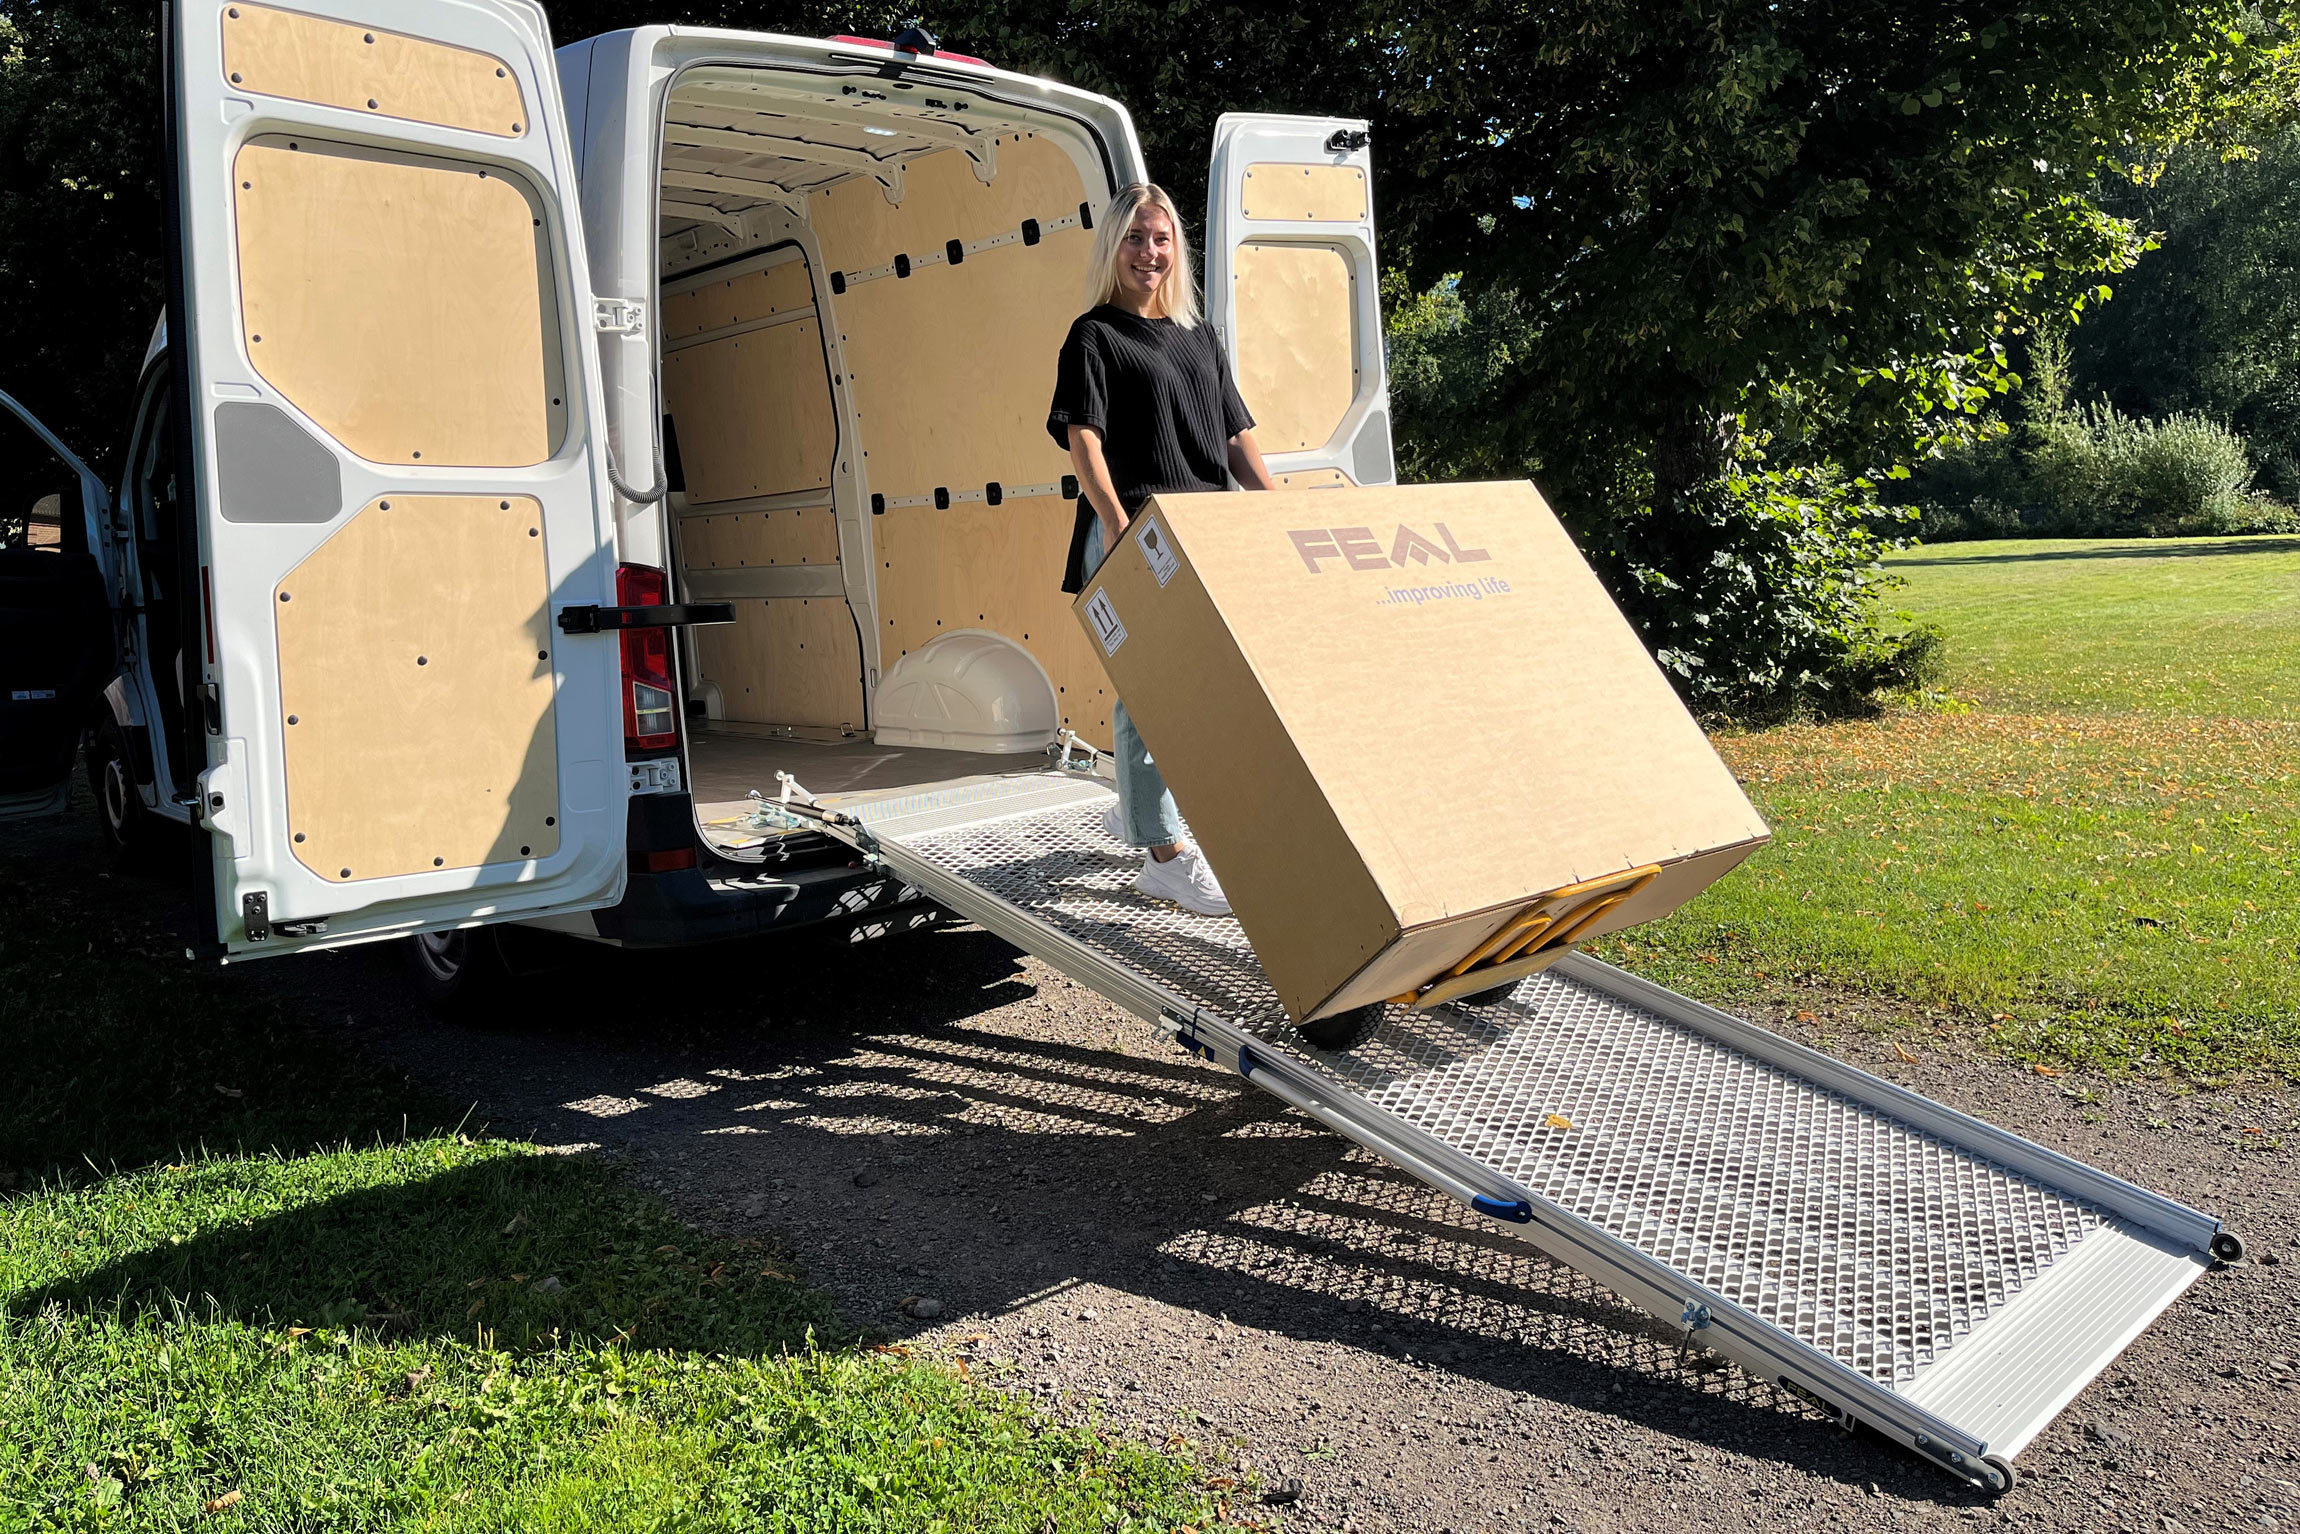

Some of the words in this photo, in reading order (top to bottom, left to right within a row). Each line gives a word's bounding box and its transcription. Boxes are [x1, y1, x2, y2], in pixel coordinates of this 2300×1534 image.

[1287, 523, 1492, 574] FEAL
[1480, 576, 1511, 595] life
[1787, 1382, 1831, 1414] FEAL
